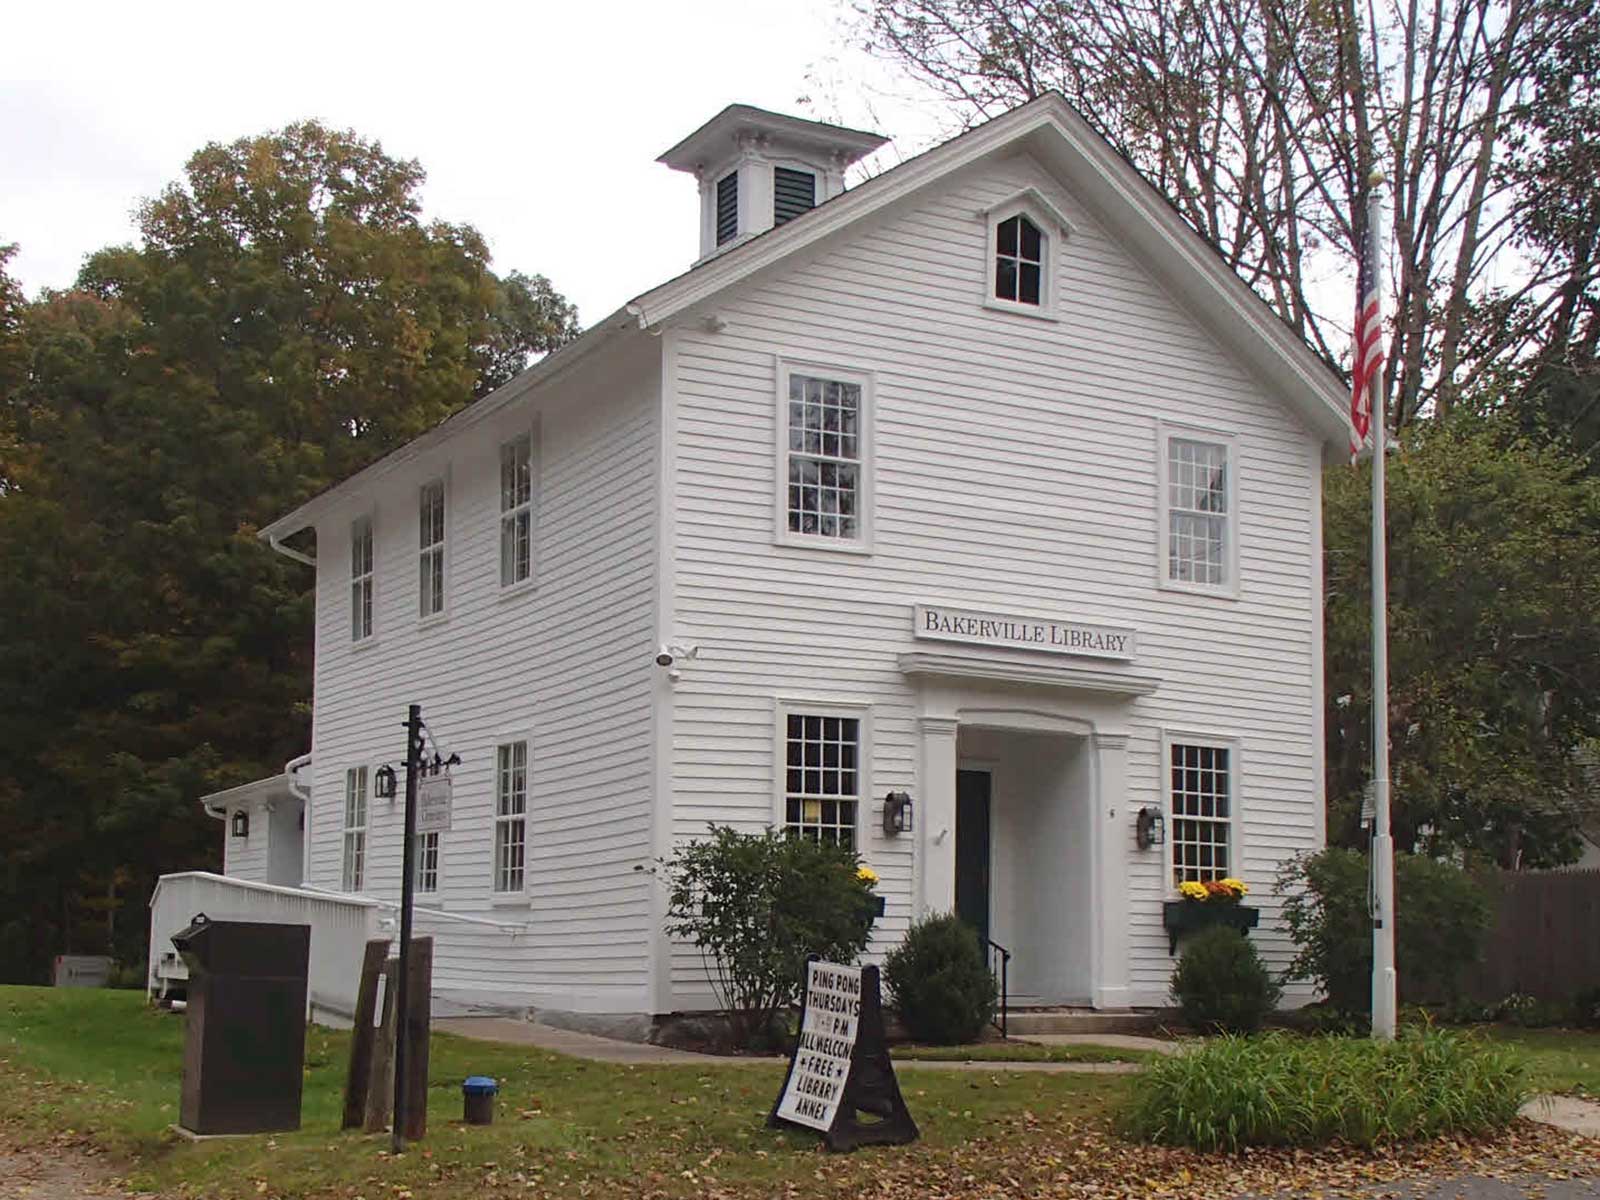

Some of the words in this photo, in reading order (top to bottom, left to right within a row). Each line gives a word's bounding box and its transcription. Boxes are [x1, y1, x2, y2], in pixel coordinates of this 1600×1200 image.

[925, 610, 1045, 643] BAKERVILLE
[1051, 625, 1128, 652] LIBRARY
[812, 970, 834, 990] PING
[836, 975, 860, 994] PONG
[807, 991, 860, 1017] THURSDAYS
[832, 1018, 849, 1036] PM
[808, 1056, 834, 1077] FREE
[796, 1075, 838, 1099] LIBRARY
[795, 1097, 828, 1119] ANNEX
